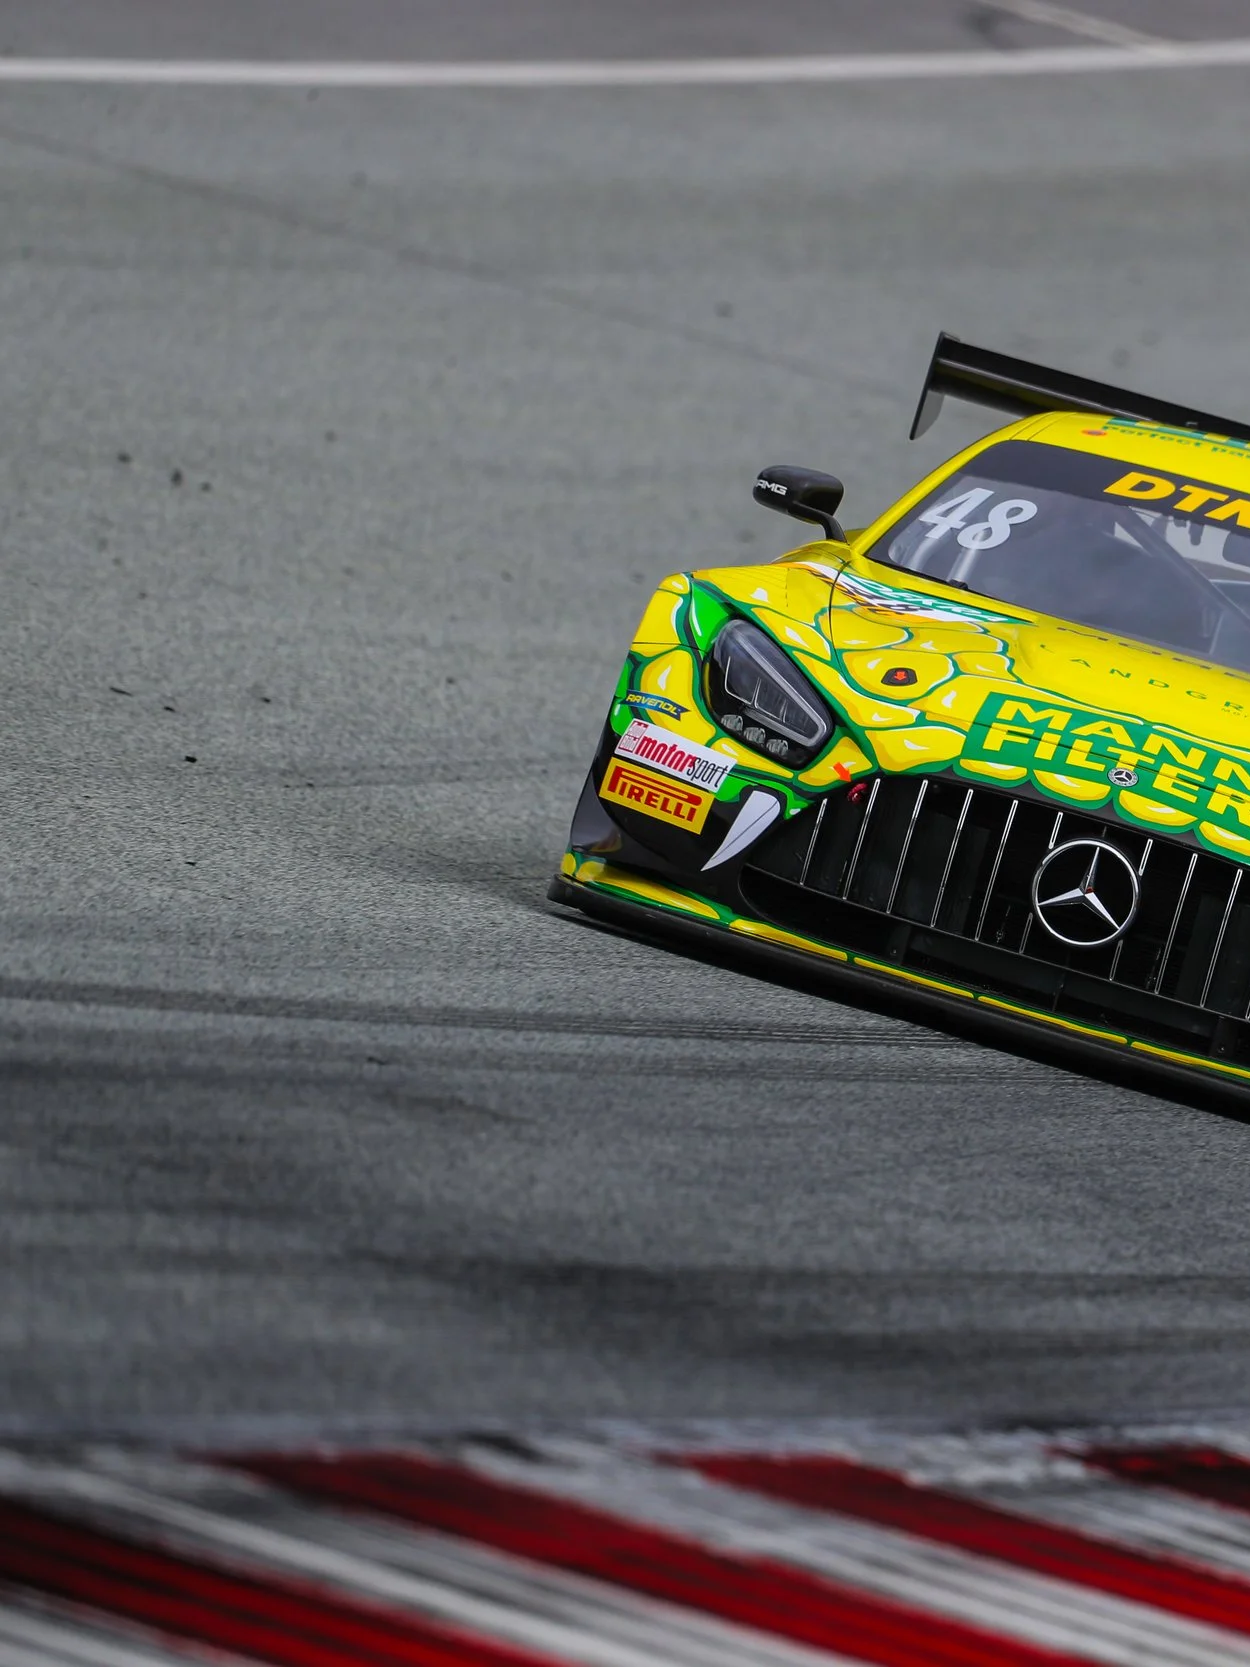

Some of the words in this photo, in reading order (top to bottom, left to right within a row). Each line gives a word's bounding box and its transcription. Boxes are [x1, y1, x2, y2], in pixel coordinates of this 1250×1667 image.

[920, 487, 1038, 550] 48
[626, 693, 679, 716] RAVENOL
[607, 765, 703, 823] PIRELLI
